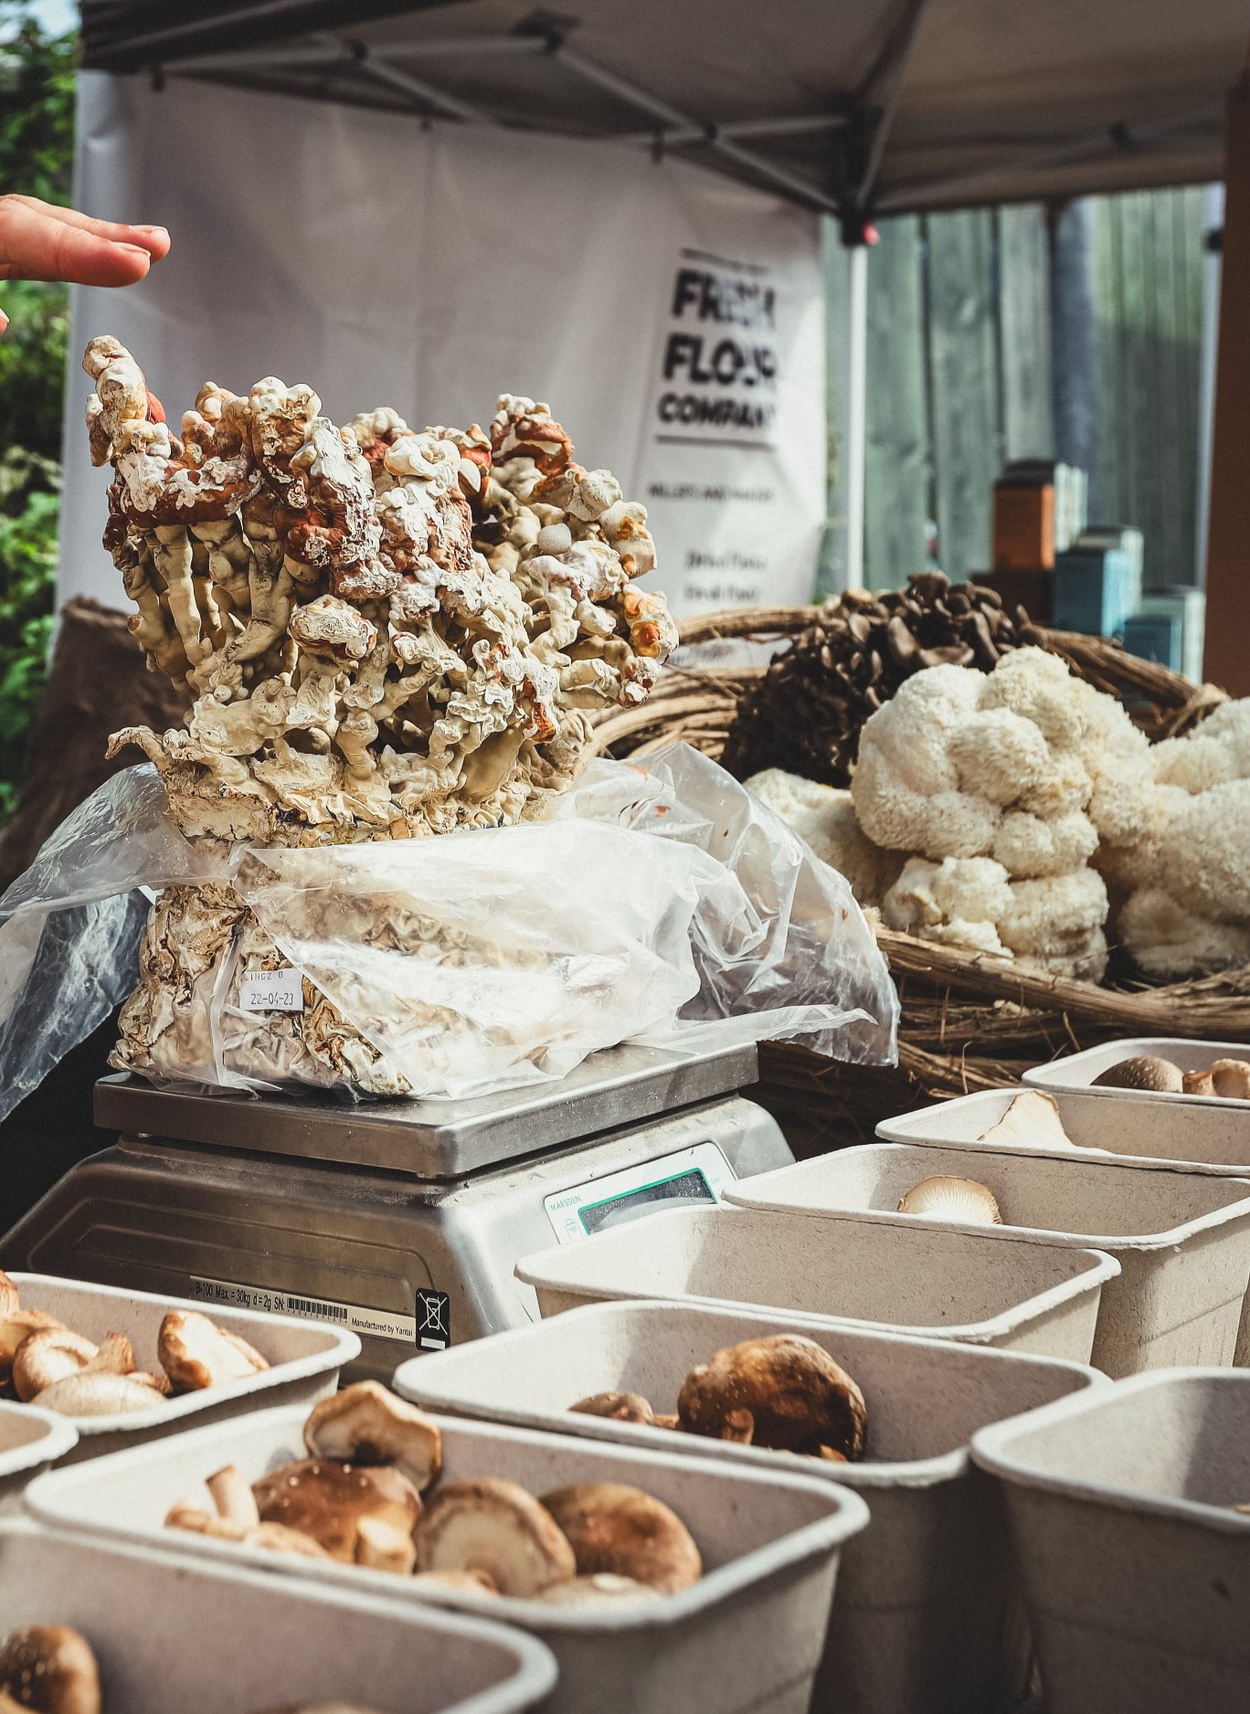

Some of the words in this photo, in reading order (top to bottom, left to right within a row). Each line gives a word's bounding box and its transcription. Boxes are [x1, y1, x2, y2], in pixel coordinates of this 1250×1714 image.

[657, 393, 775, 429] COMPAN
[250, 992, 294, 1006] 22-04-23
[550, 1195, 582, 1210] MARSDEN
[236, 1289, 251, 1307] 30kg
[351, 1318, 387, 1332] Manufactured
[387, 1324, 395, 1336] by
[396, 1326, 413, 1337] Yantai
